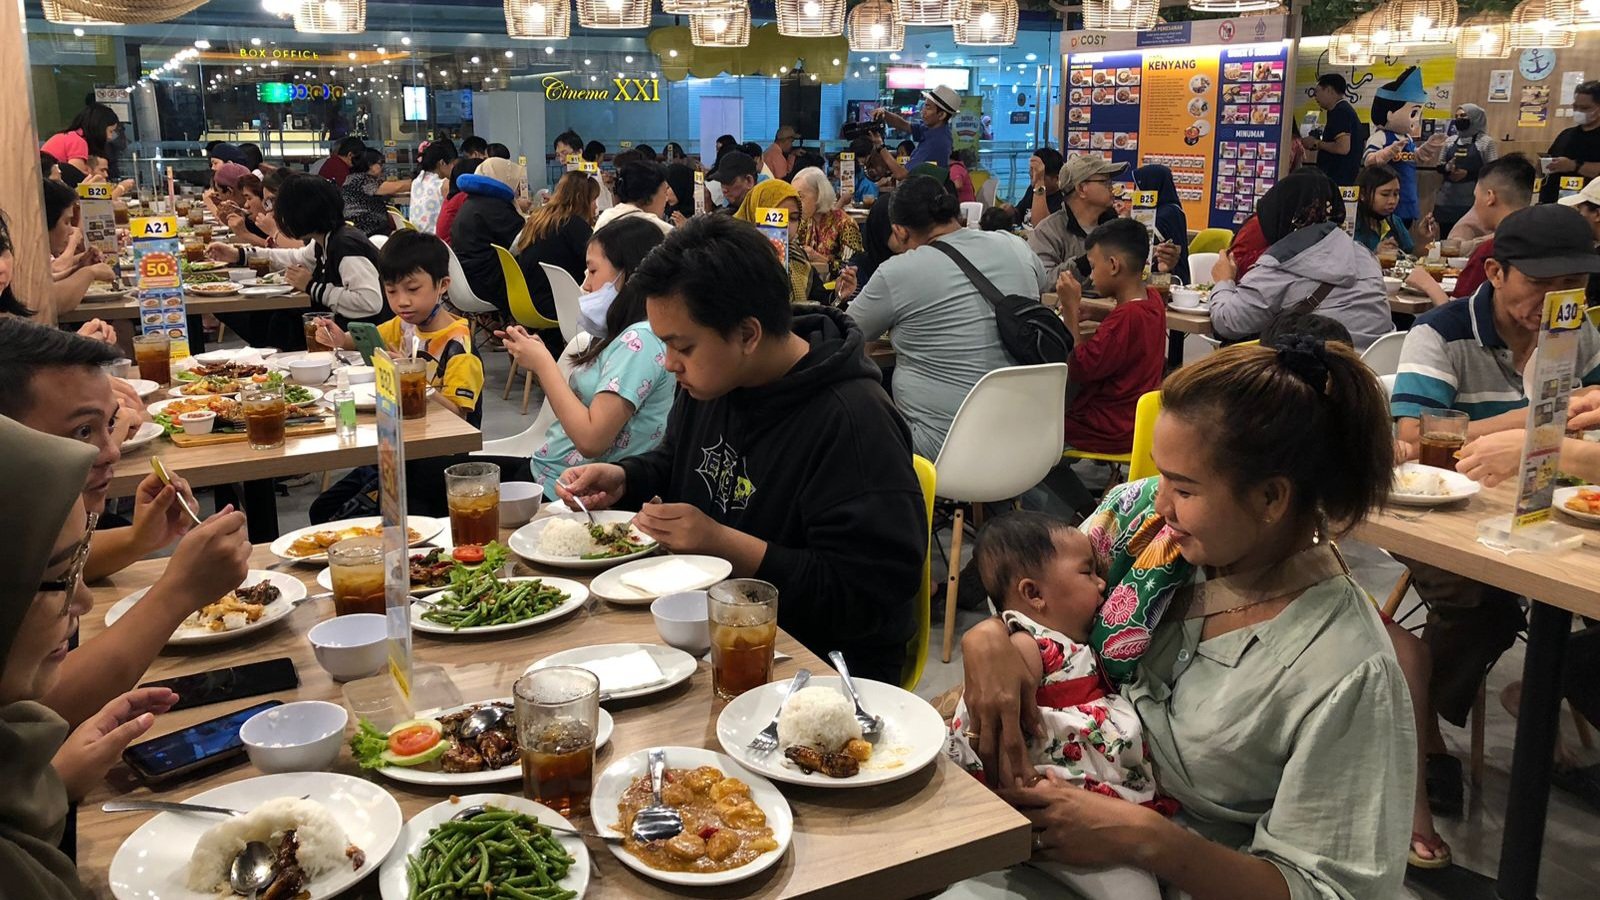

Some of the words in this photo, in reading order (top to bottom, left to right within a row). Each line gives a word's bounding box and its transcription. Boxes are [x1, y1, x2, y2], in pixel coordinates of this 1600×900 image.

[1071, 34, 1106, 48] D'COST
[240, 48, 266, 58] BOX
[1148, 59, 1196, 71] KENYANG
[541, 76, 609, 101] Cinema
[613, 78, 660, 101] XXI
[1235, 130, 1265, 138] MINUMAN
[88, 187, 107, 196] B20
[1140, 194, 1155, 203] B25
[765, 212, 784, 222] A22
[144, 222, 170, 234] A21
[1555, 302, 1578, 322] A30
